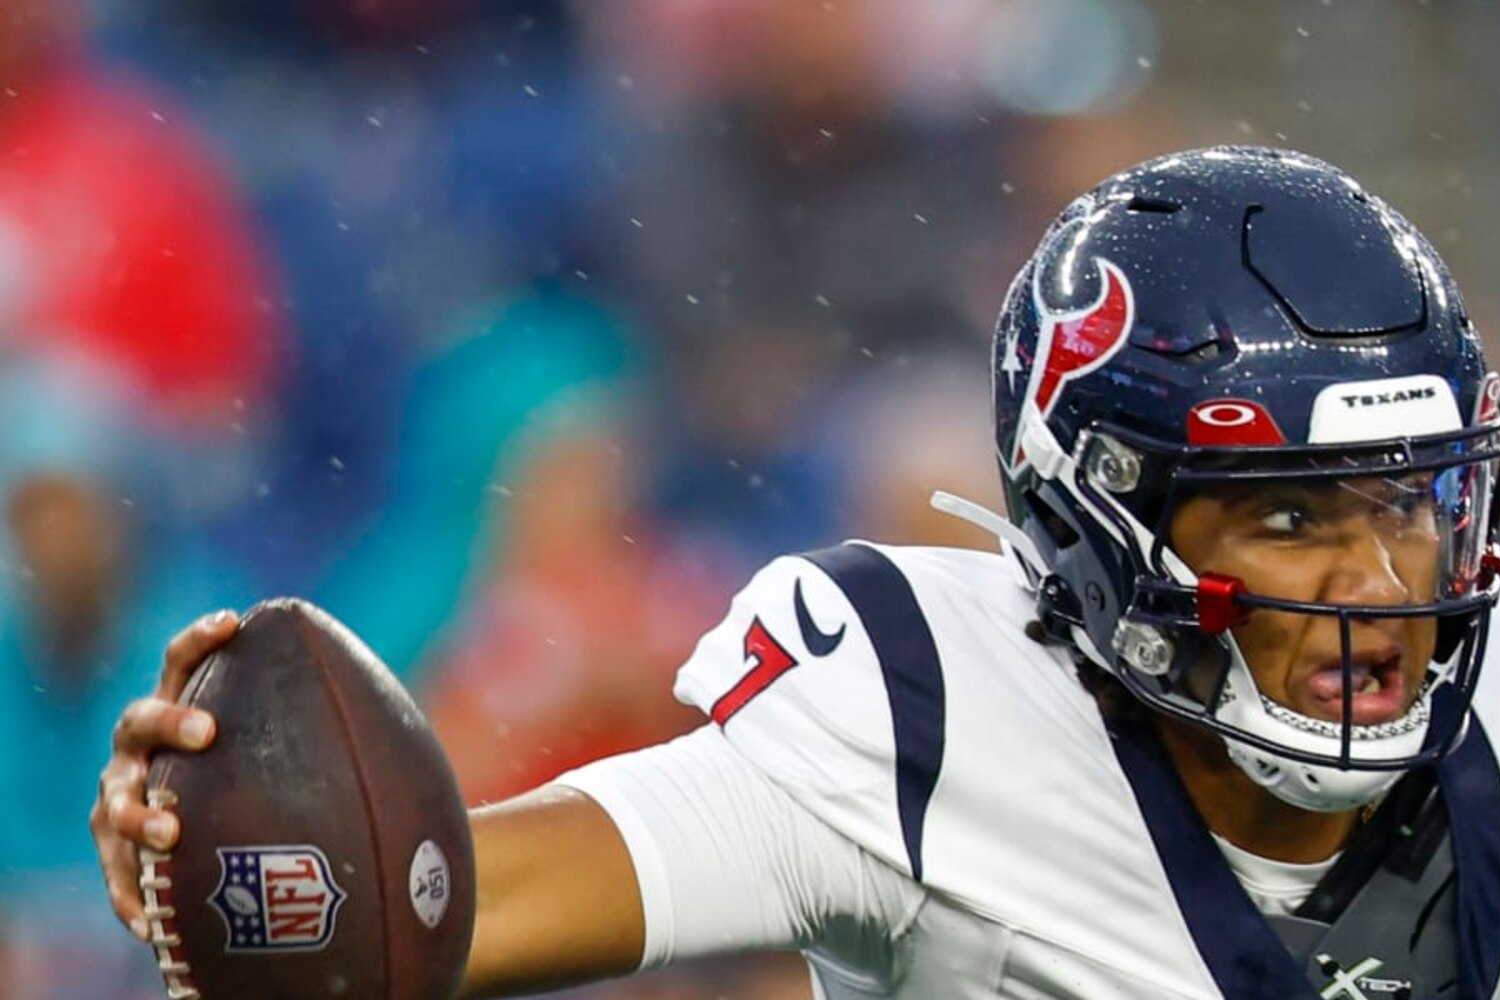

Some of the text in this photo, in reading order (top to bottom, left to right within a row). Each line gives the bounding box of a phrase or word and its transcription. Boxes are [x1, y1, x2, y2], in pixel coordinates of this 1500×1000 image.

[1340, 386, 1437, 409] TEXANS
[709, 613, 800, 729] 7
[265, 857, 327, 941] NFL
